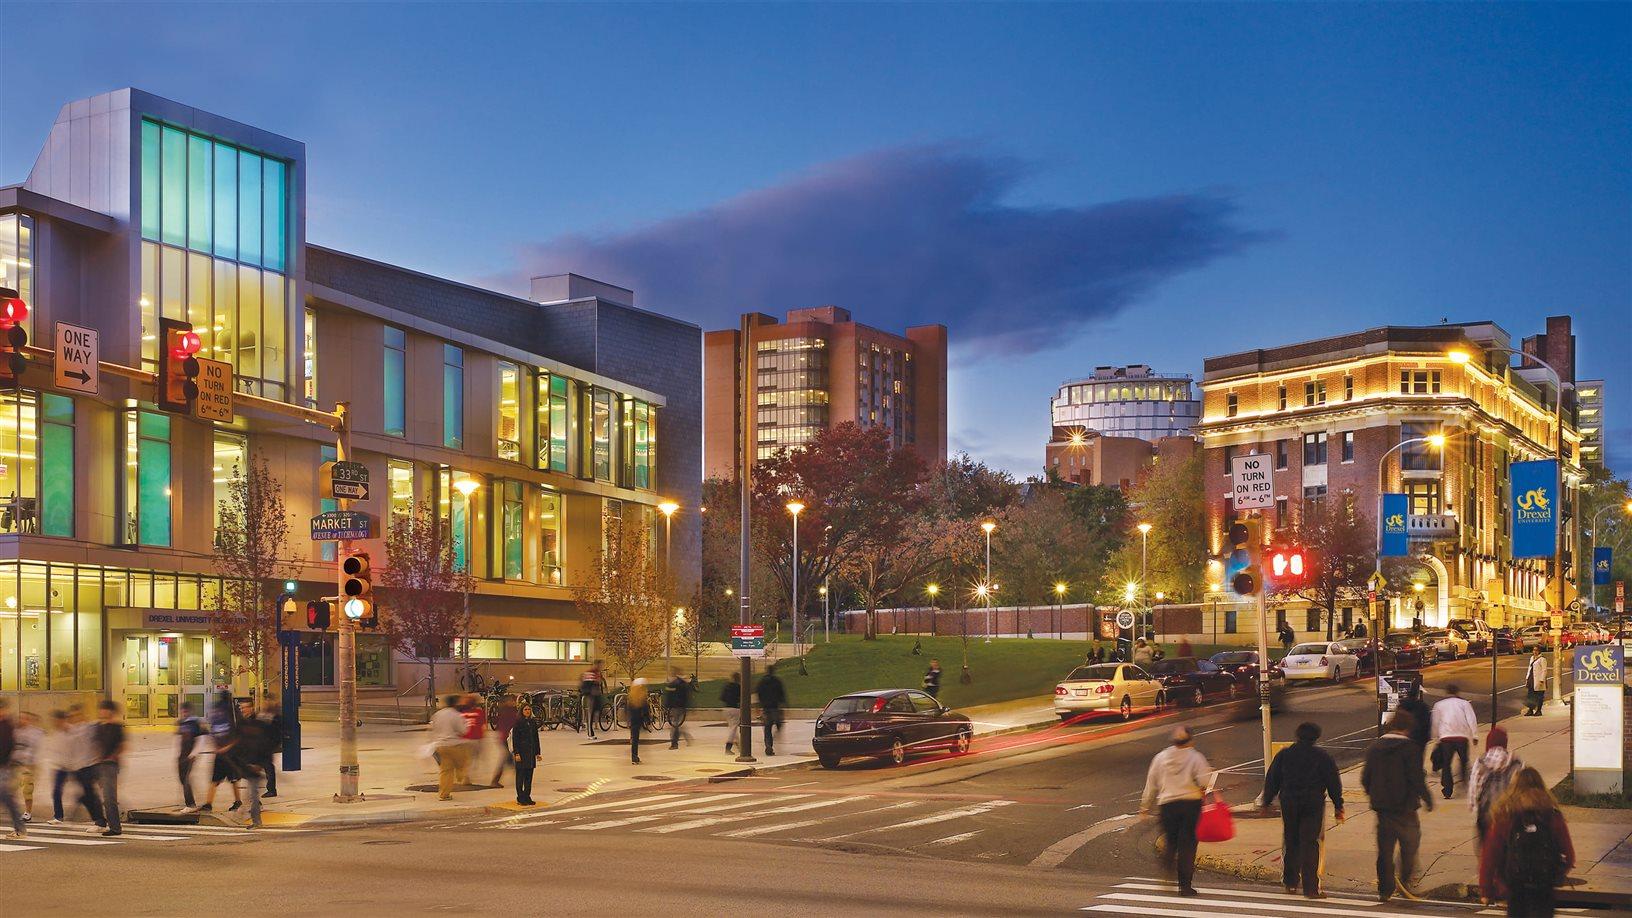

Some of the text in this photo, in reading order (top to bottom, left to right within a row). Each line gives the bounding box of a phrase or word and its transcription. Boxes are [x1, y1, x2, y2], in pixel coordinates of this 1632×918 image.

[64, 329, 90, 348] ONE
[63, 346, 92, 365] WAY
[206, 365, 222, 379] NO
[203, 378, 225, 392] TURN
[200, 391, 230, 406] ON RED
[1244, 460, 1260, 470] NO
[339, 468, 368, 482] 33RD ST
[1241, 471, 1265, 481] TURN
[335, 484, 358, 494] ONE WAY
[1236, 482, 1271, 494] ON RED
[1517, 507, 1552, 520] Drexel
[312, 518, 368, 530] MARKET ST
[149, 614, 175, 623] DREXEL
[176, 616, 211, 624] UNIVERSITY
[1577, 668, 1621, 682] Drexel
